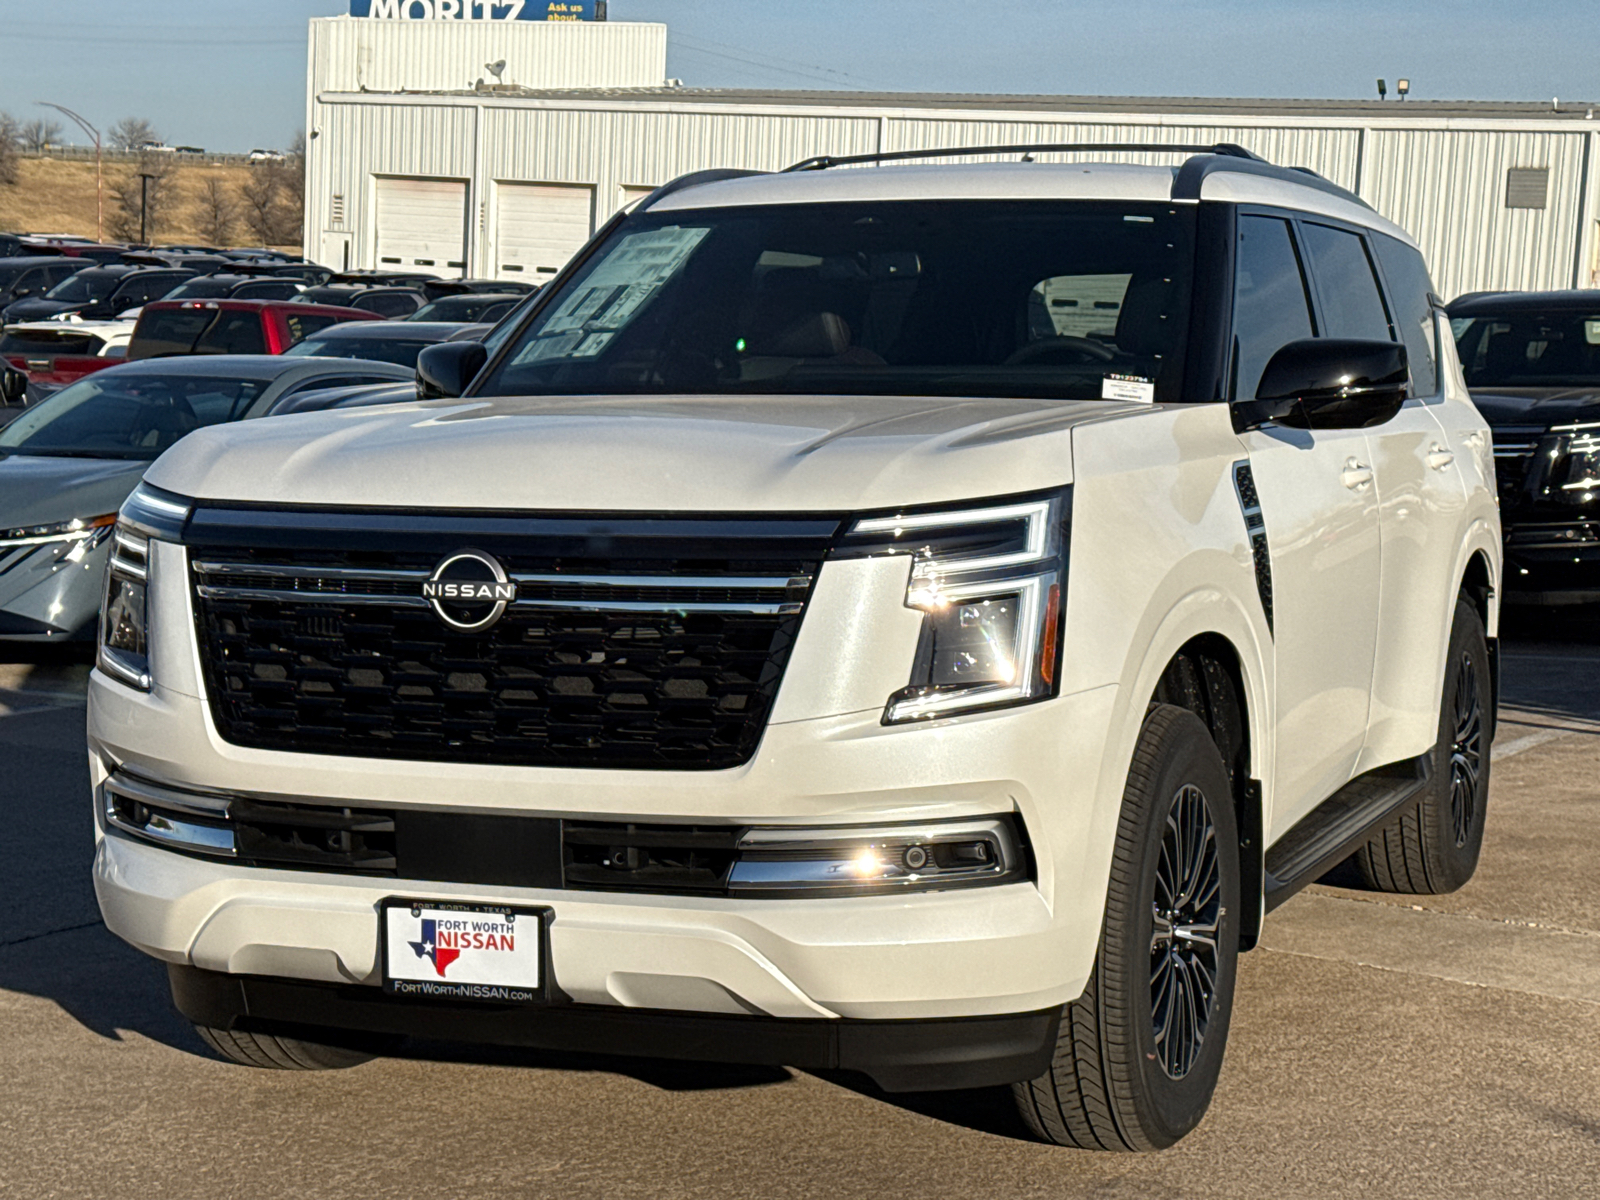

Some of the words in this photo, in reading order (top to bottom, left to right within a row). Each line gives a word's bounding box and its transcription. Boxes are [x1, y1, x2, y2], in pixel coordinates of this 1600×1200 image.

[368, 0, 526, 21] MORITZ
[548, 2, 568, 13] Ask
[570, 5, 583, 13] us
[423, 583, 511, 598] NISSAN
[483, 906, 512, 915] TEXAS
[438, 919, 469, 931] FORT
[472, 921, 515, 934] WORTH
[438, 930, 515, 952] NISSAN
